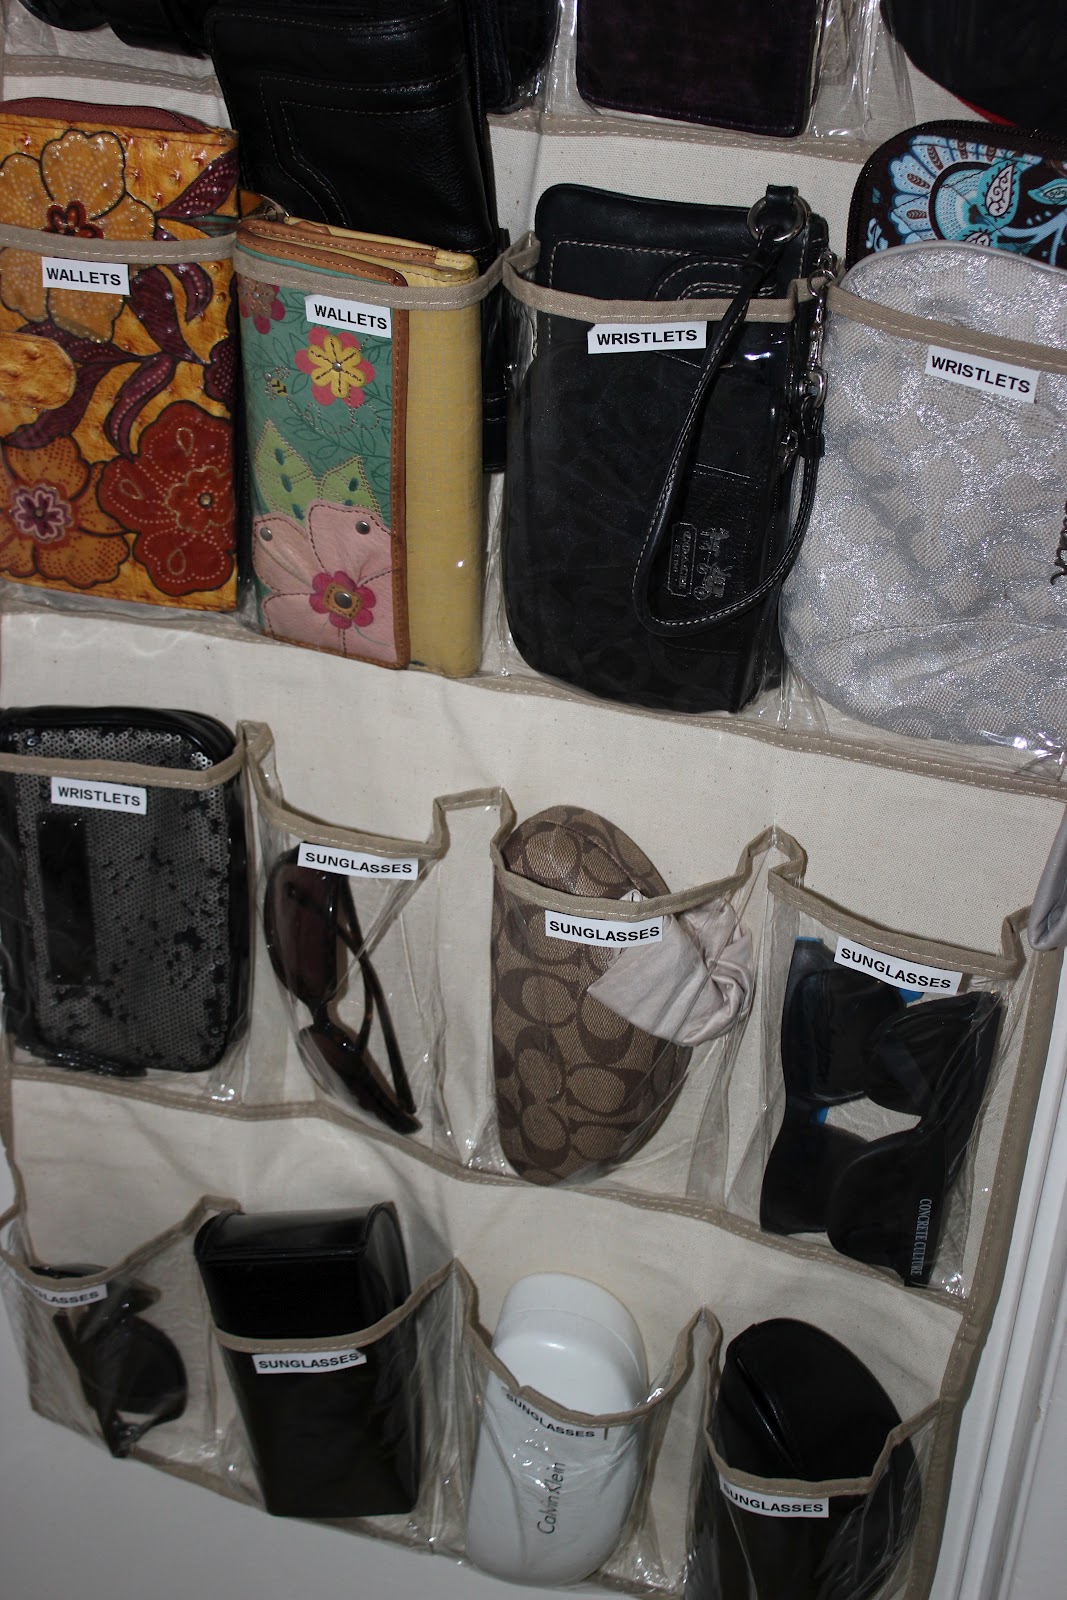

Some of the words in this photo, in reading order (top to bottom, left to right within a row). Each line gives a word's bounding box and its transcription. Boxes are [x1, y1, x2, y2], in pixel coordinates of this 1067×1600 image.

[46, 267, 121, 286] WALLETS
[314, 303, 388, 330] WALLETS
[596, 329, 698, 346] WRISTLETS
[931, 355, 1031, 394] WRISTLETS
[57, 786, 141, 807] WRISTLETS
[305, 852, 413, 874] SUNGLASSES
[549, 920, 660, 942] SUNGLASSES
[840, 948, 952, 989] SUNGLASSES
[915, 1198, 932, 1241] CONCRETE
[910, 1241, 927, 1276] CULTURE
[258, 1352, 360, 1369] SUNGLASSES
[505, 1393, 595, 1437] SUNGLASSES
[543, 1462, 566, 1495] Klein
[723, 1483, 824, 1513] SUNGLASSES
[536, 1495, 560, 1535] Calvin
